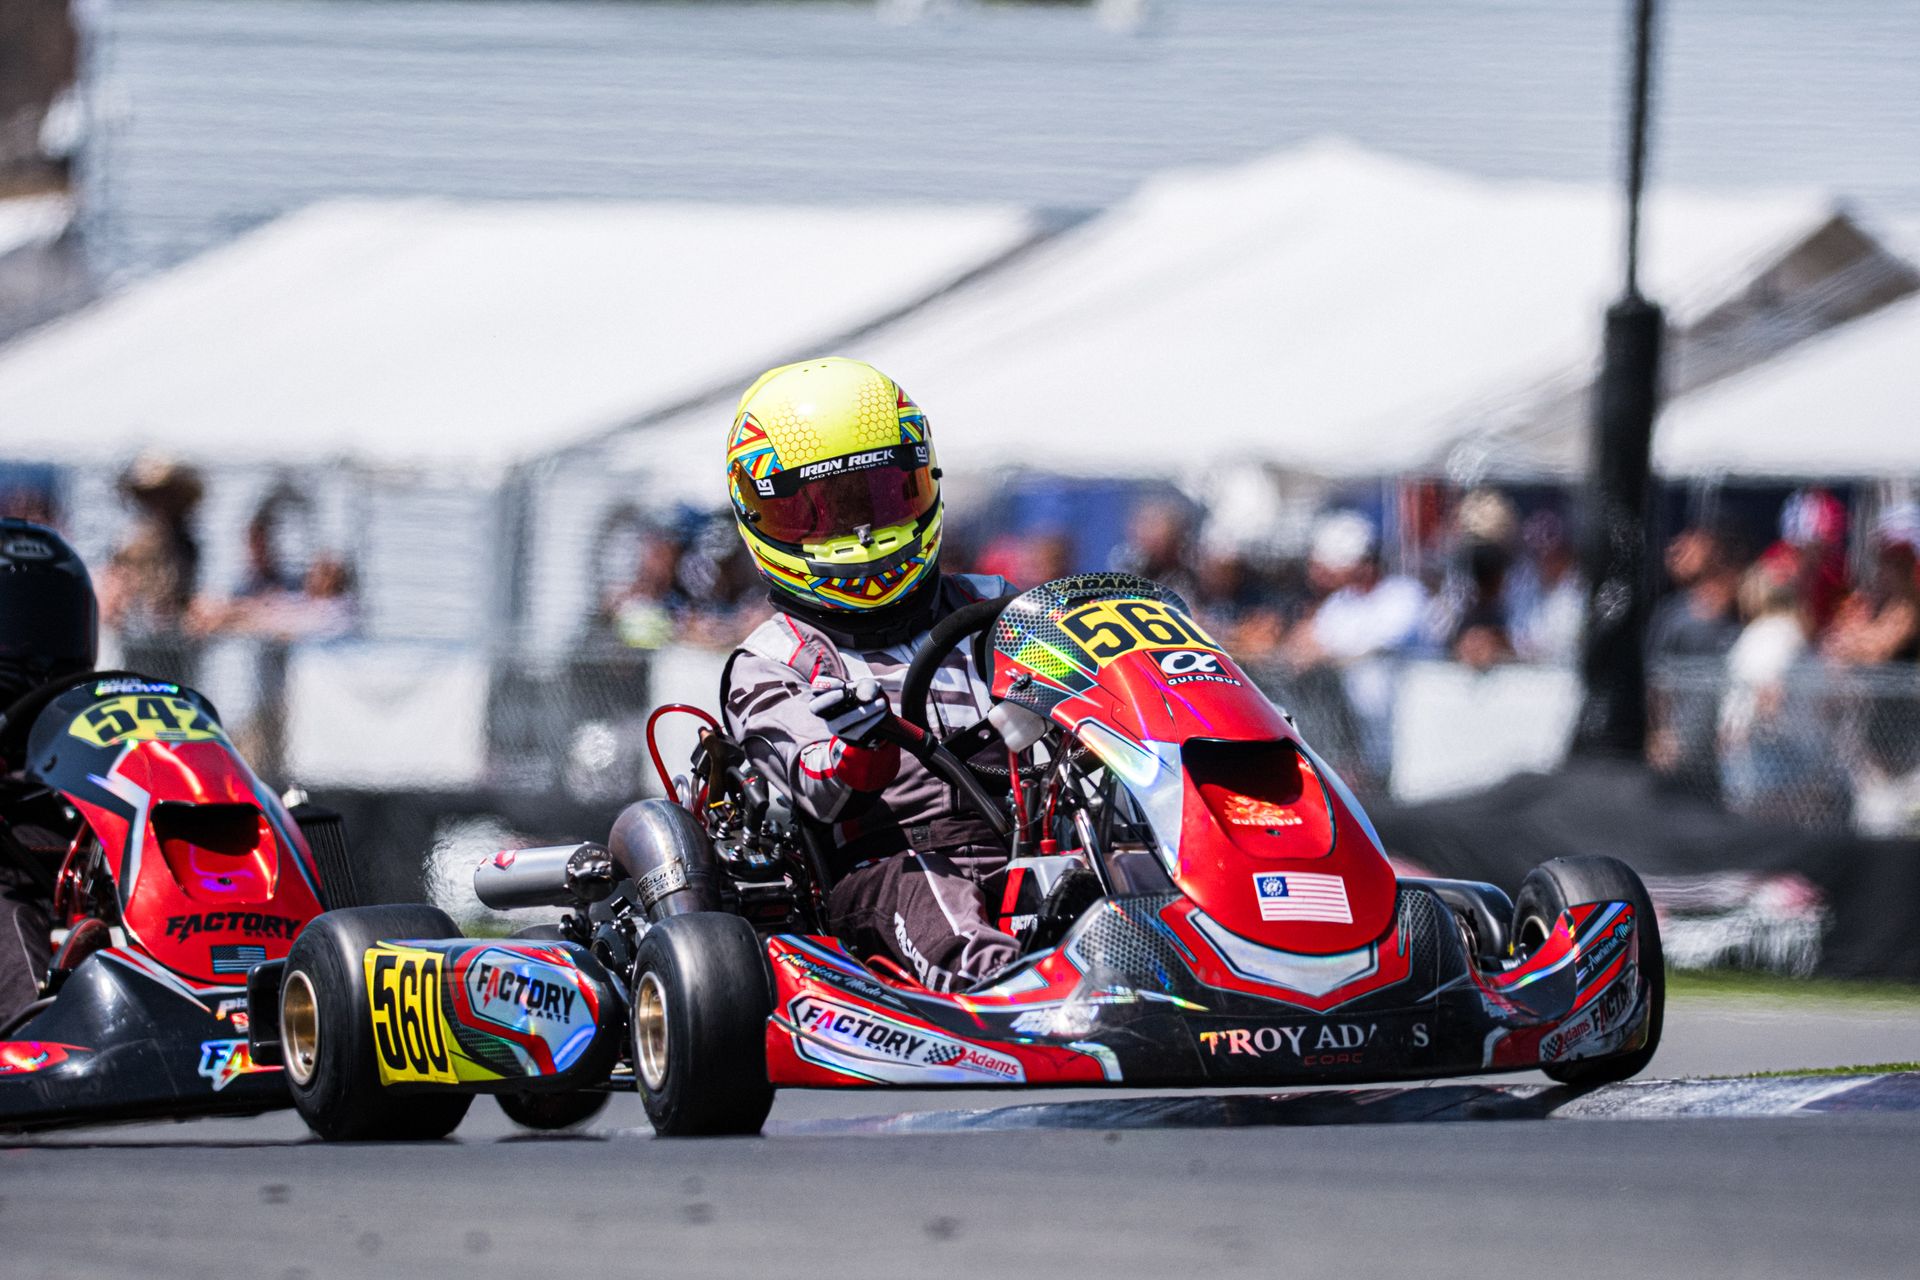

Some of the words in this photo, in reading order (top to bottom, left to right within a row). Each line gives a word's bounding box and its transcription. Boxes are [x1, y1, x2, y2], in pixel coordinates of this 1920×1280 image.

[799, 458, 843, 478] IRON
[848, 449, 895, 466] ROCK
[1167, 674, 1242, 687] autohaus
[165, 911, 300, 943] FACTORY
[476, 963, 576, 1017] FACTORY
[373, 954, 449, 1075] 560
[524, 1007, 571, 1025] KARTS
[802, 1005, 926, 1056] FACTORY
[1199, 1025, 1307, 1058] TROY
[962, 1049, 1019, 1076] Adams
